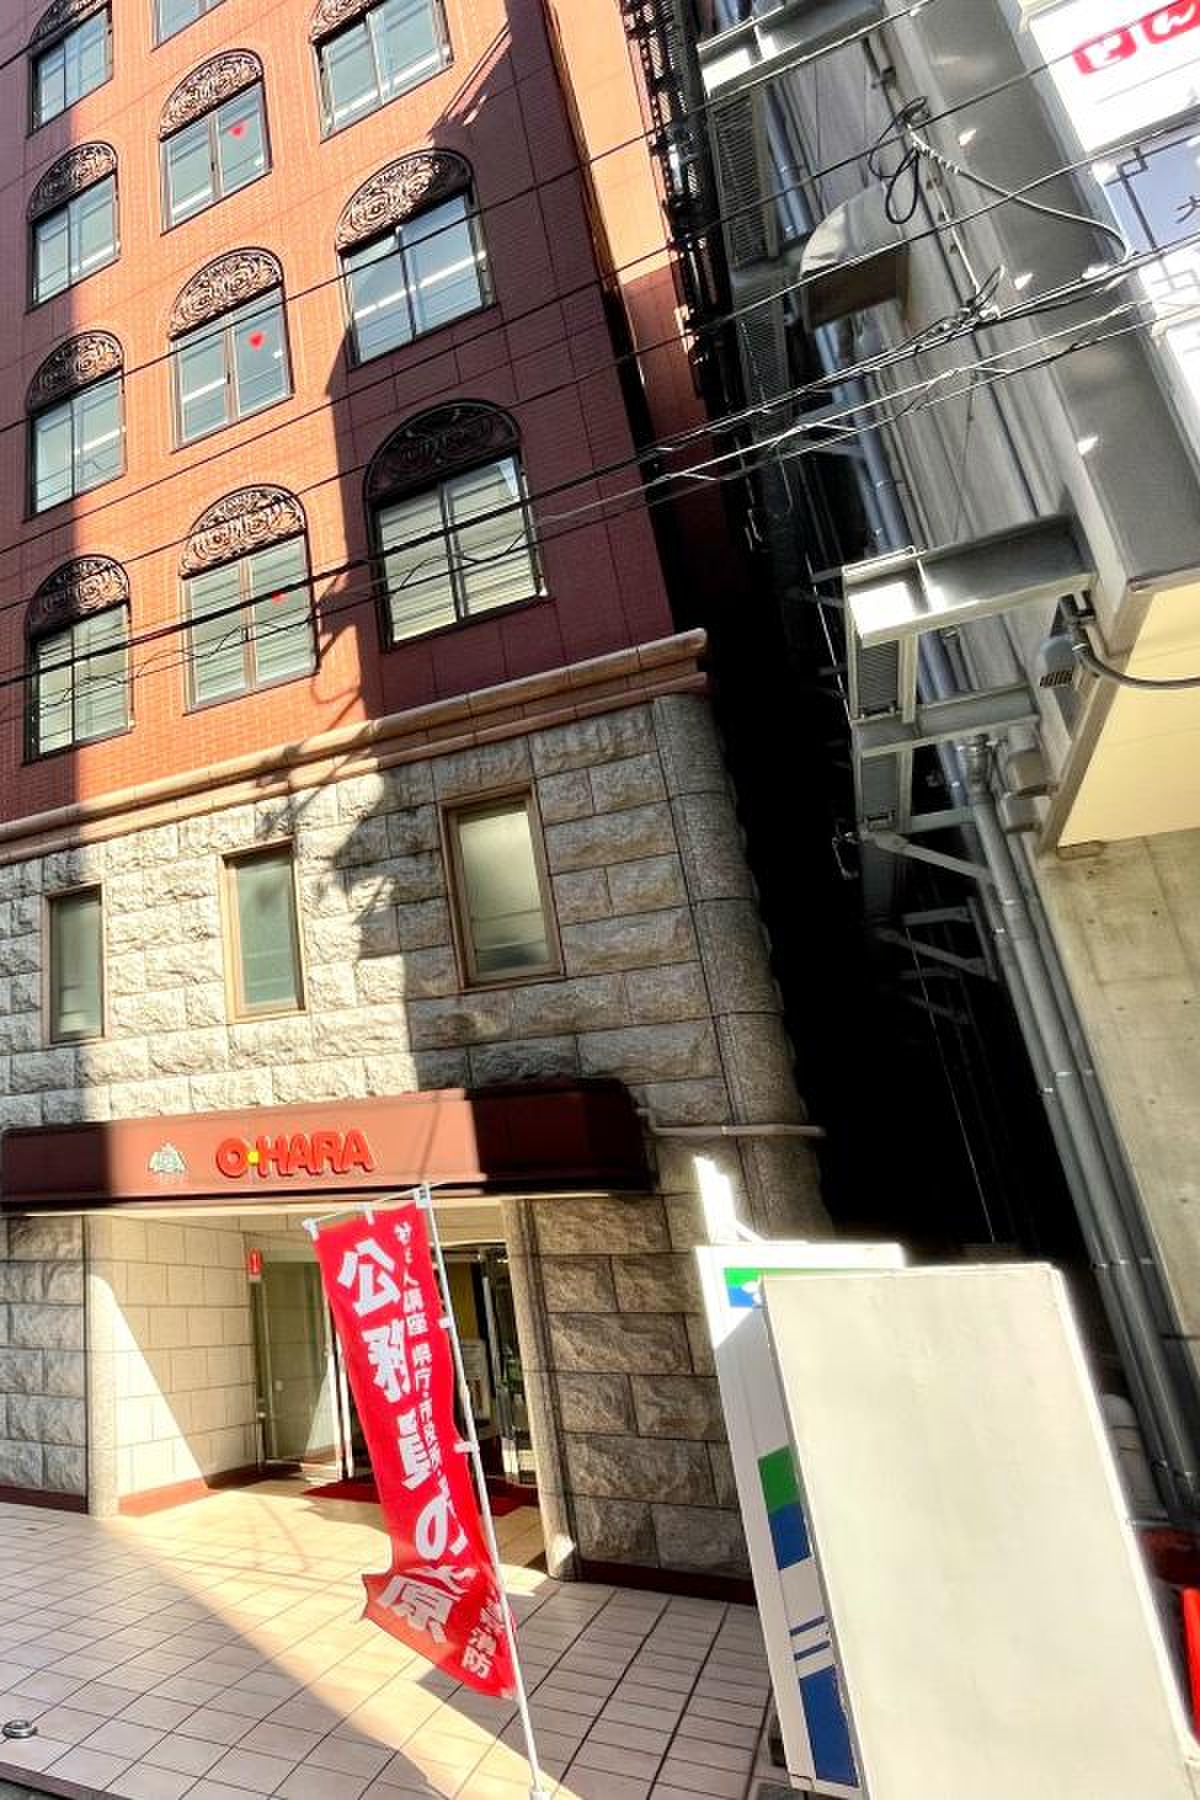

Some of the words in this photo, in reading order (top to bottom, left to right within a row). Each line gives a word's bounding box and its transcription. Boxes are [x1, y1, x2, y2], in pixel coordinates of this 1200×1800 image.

[337, 1237, 480, 1645] 公務員の大原
